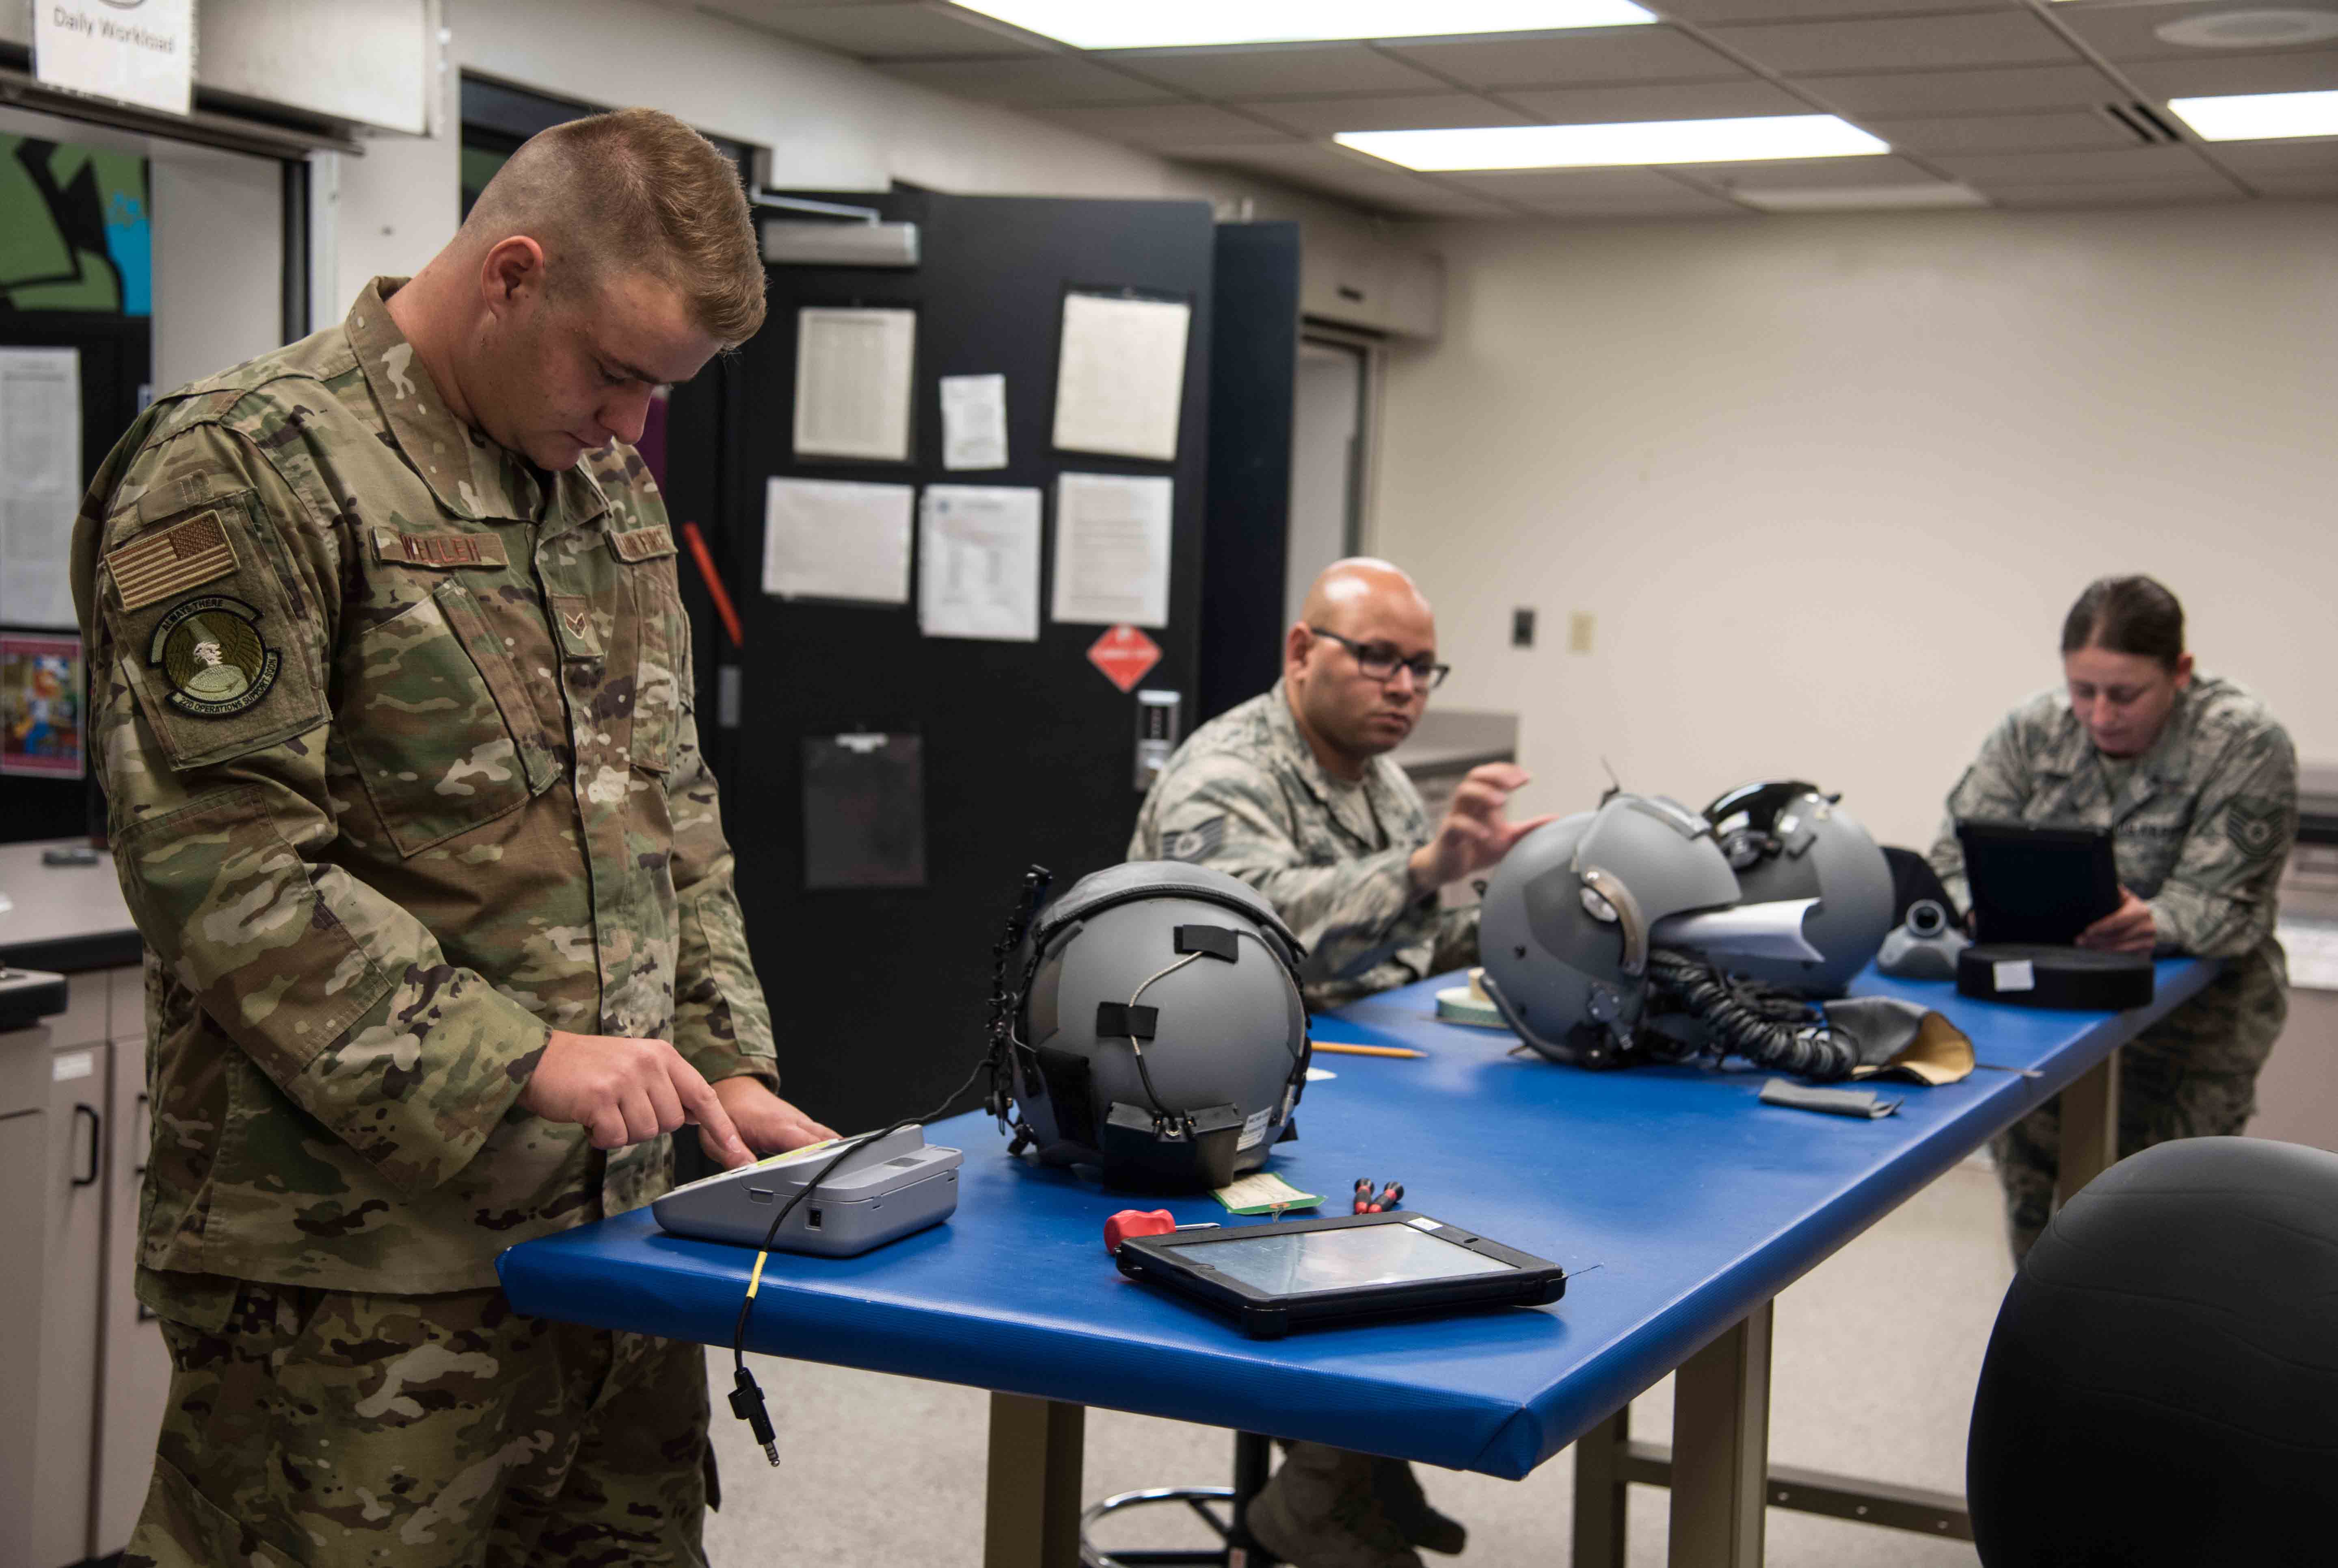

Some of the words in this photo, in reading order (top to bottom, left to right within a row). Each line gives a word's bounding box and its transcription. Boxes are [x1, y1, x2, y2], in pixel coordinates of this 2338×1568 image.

[54, 6, 93, 37] Daily
[99, 17, 175, 53] Workload
[400, 533, 481, 563] WELLER
[162, 605, 192, 631] ALWAYS
[193, 598, 223, 609] THERE
[194, 700, 242, 712] OPERATIONS
[242, 678, 270, 703] SUPPORT
